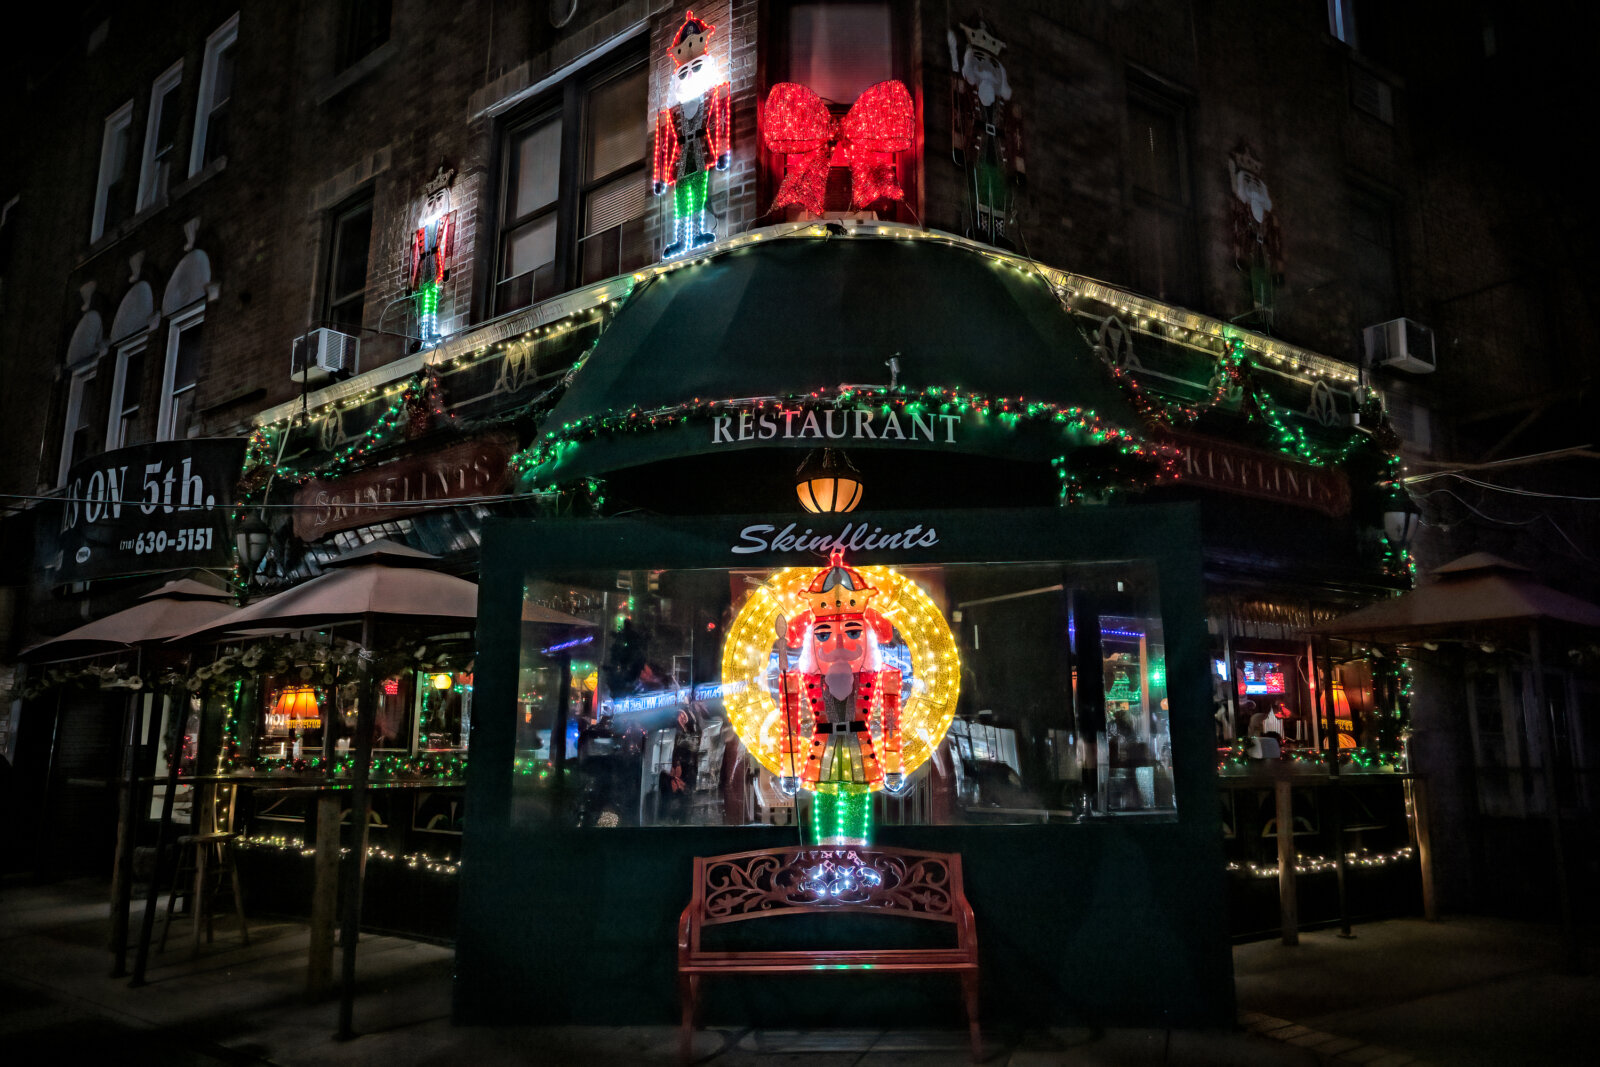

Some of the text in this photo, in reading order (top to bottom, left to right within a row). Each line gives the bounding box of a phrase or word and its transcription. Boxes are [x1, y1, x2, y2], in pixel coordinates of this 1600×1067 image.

[712, 409, 961, 443] RESTAURANT
[85, 465, 129, 523] ON
[140, 457, 215, 515] 5th.
[135, 527, 214, 556] 630-5151
[731, 522, 941, 554] Skinflints
